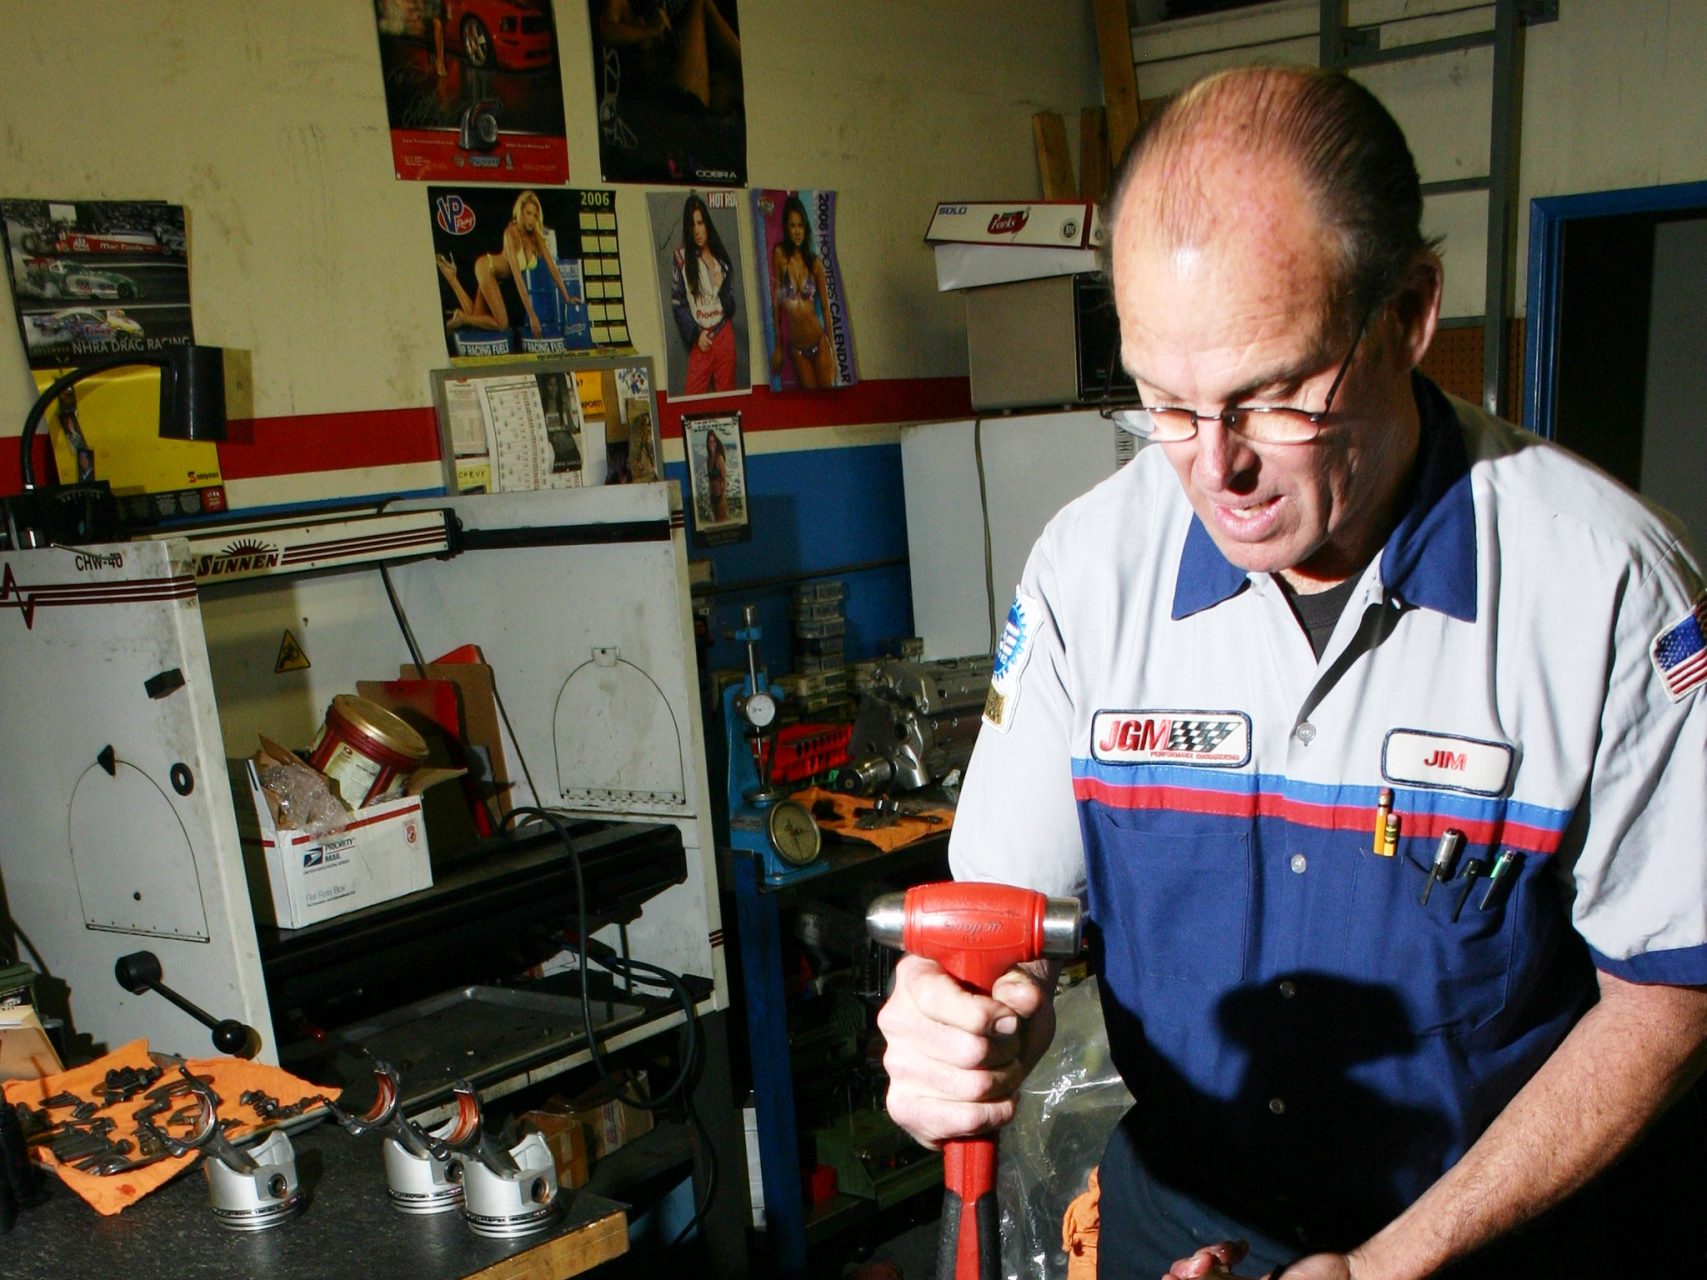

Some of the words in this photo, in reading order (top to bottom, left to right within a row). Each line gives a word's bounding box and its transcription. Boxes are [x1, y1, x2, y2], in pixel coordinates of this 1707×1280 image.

[696, 171, 737, 179] COBRA
[580, 191, 610, 206] 2006
[709, 191, 724, 208] HOT
[725, 191, 738, 207] RO
[437, 194, 464, 233] VP
[938, 206, 967, 215] SOLO
[990, 215, 1016, 231] Forks
[818, 193, 830, 231] 2008
[829, 302, 851, 384] CALENDAR
[72, 340, 108, 355] NHRA
[112, 338, 144, 352] DRAG
[458, 470, 487, 479] CHEVY
[75, 552, 123, 571] CHW-40
[197, 552, 279, 577] SUNNEN
[1099, 719, 1171, 752] JGM
[1424, 750, 1467, 771] JIM
[325, 838, 353, 851] PRIORITY
[325, 852, 341, 861] MAIL
[334, 885, 346, 893] Box
